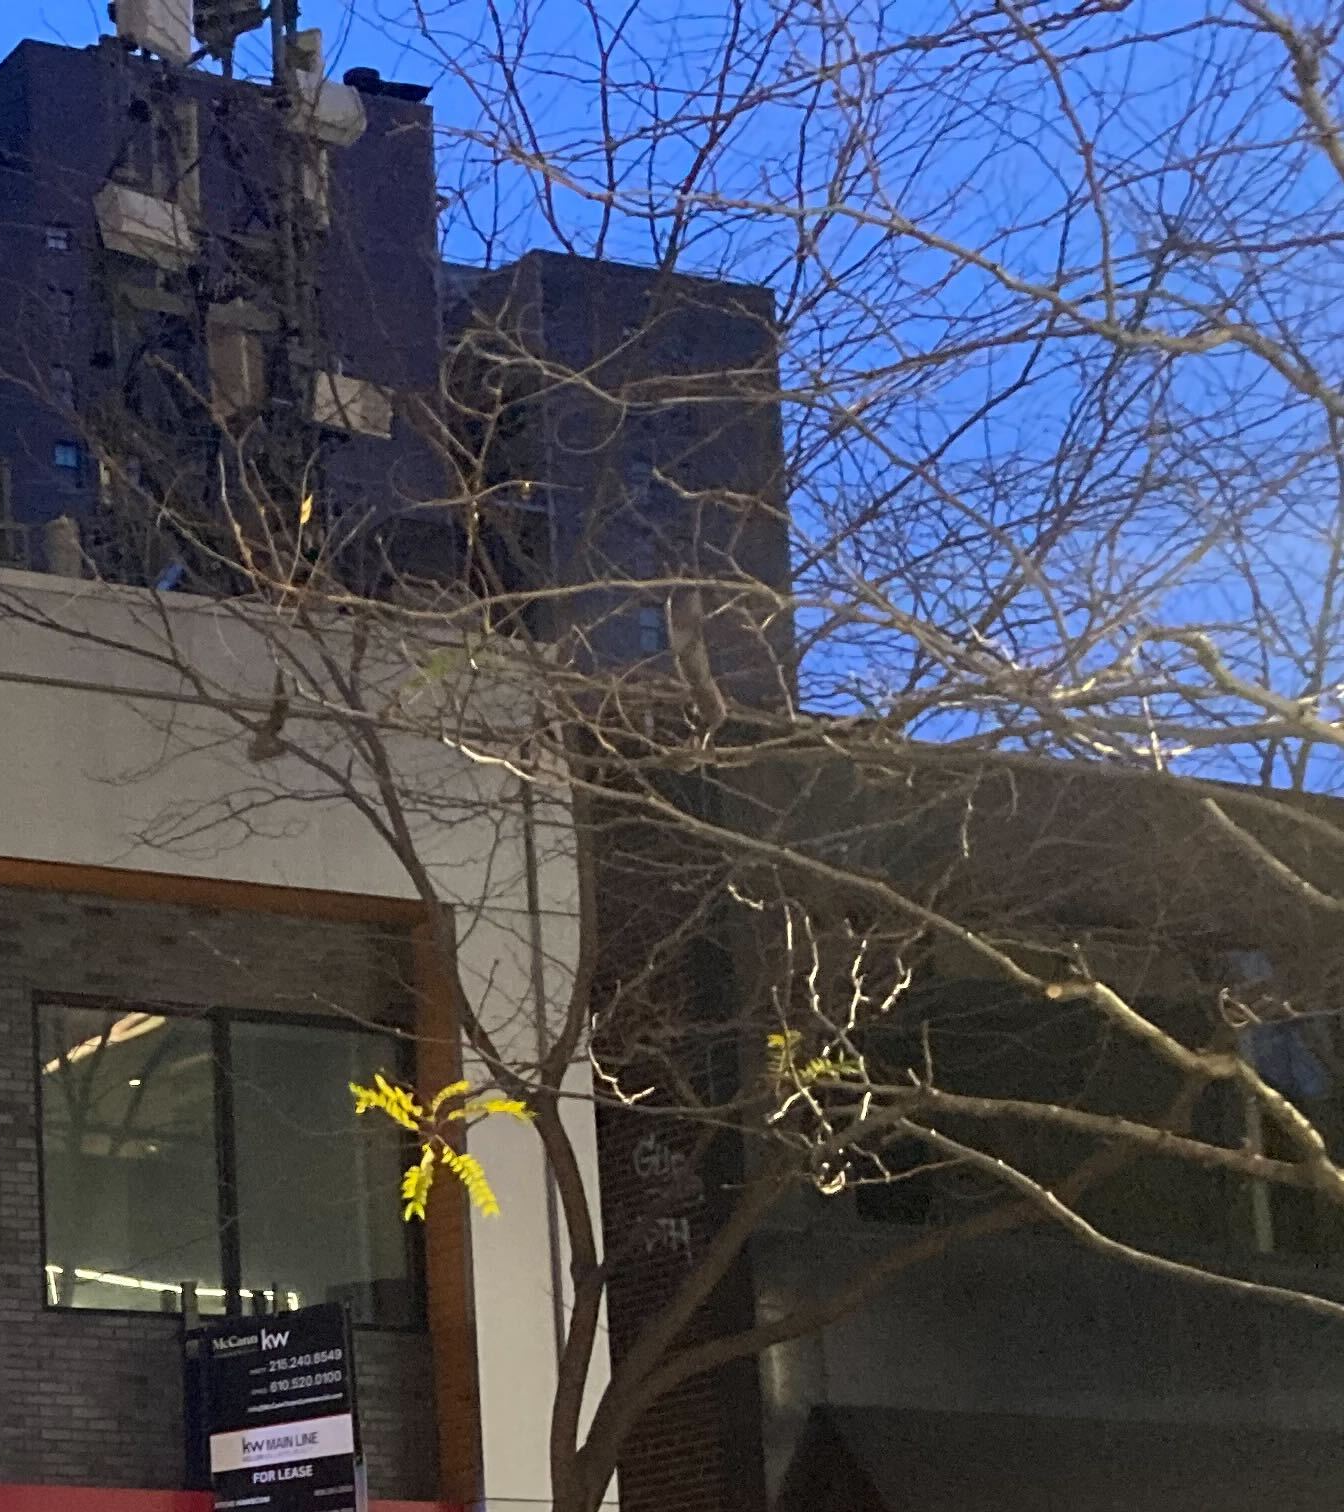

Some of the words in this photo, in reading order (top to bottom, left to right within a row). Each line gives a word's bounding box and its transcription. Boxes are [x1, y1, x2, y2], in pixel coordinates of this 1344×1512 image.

[260, 1328, 290, 1351] kw
[266, 1436, 294, 1451] MAIN
[295, 1431, 319, 1447] LINE
[253, 1470, 276, 1484] FOR
[277, 1464, 314, 1481] LEASE
